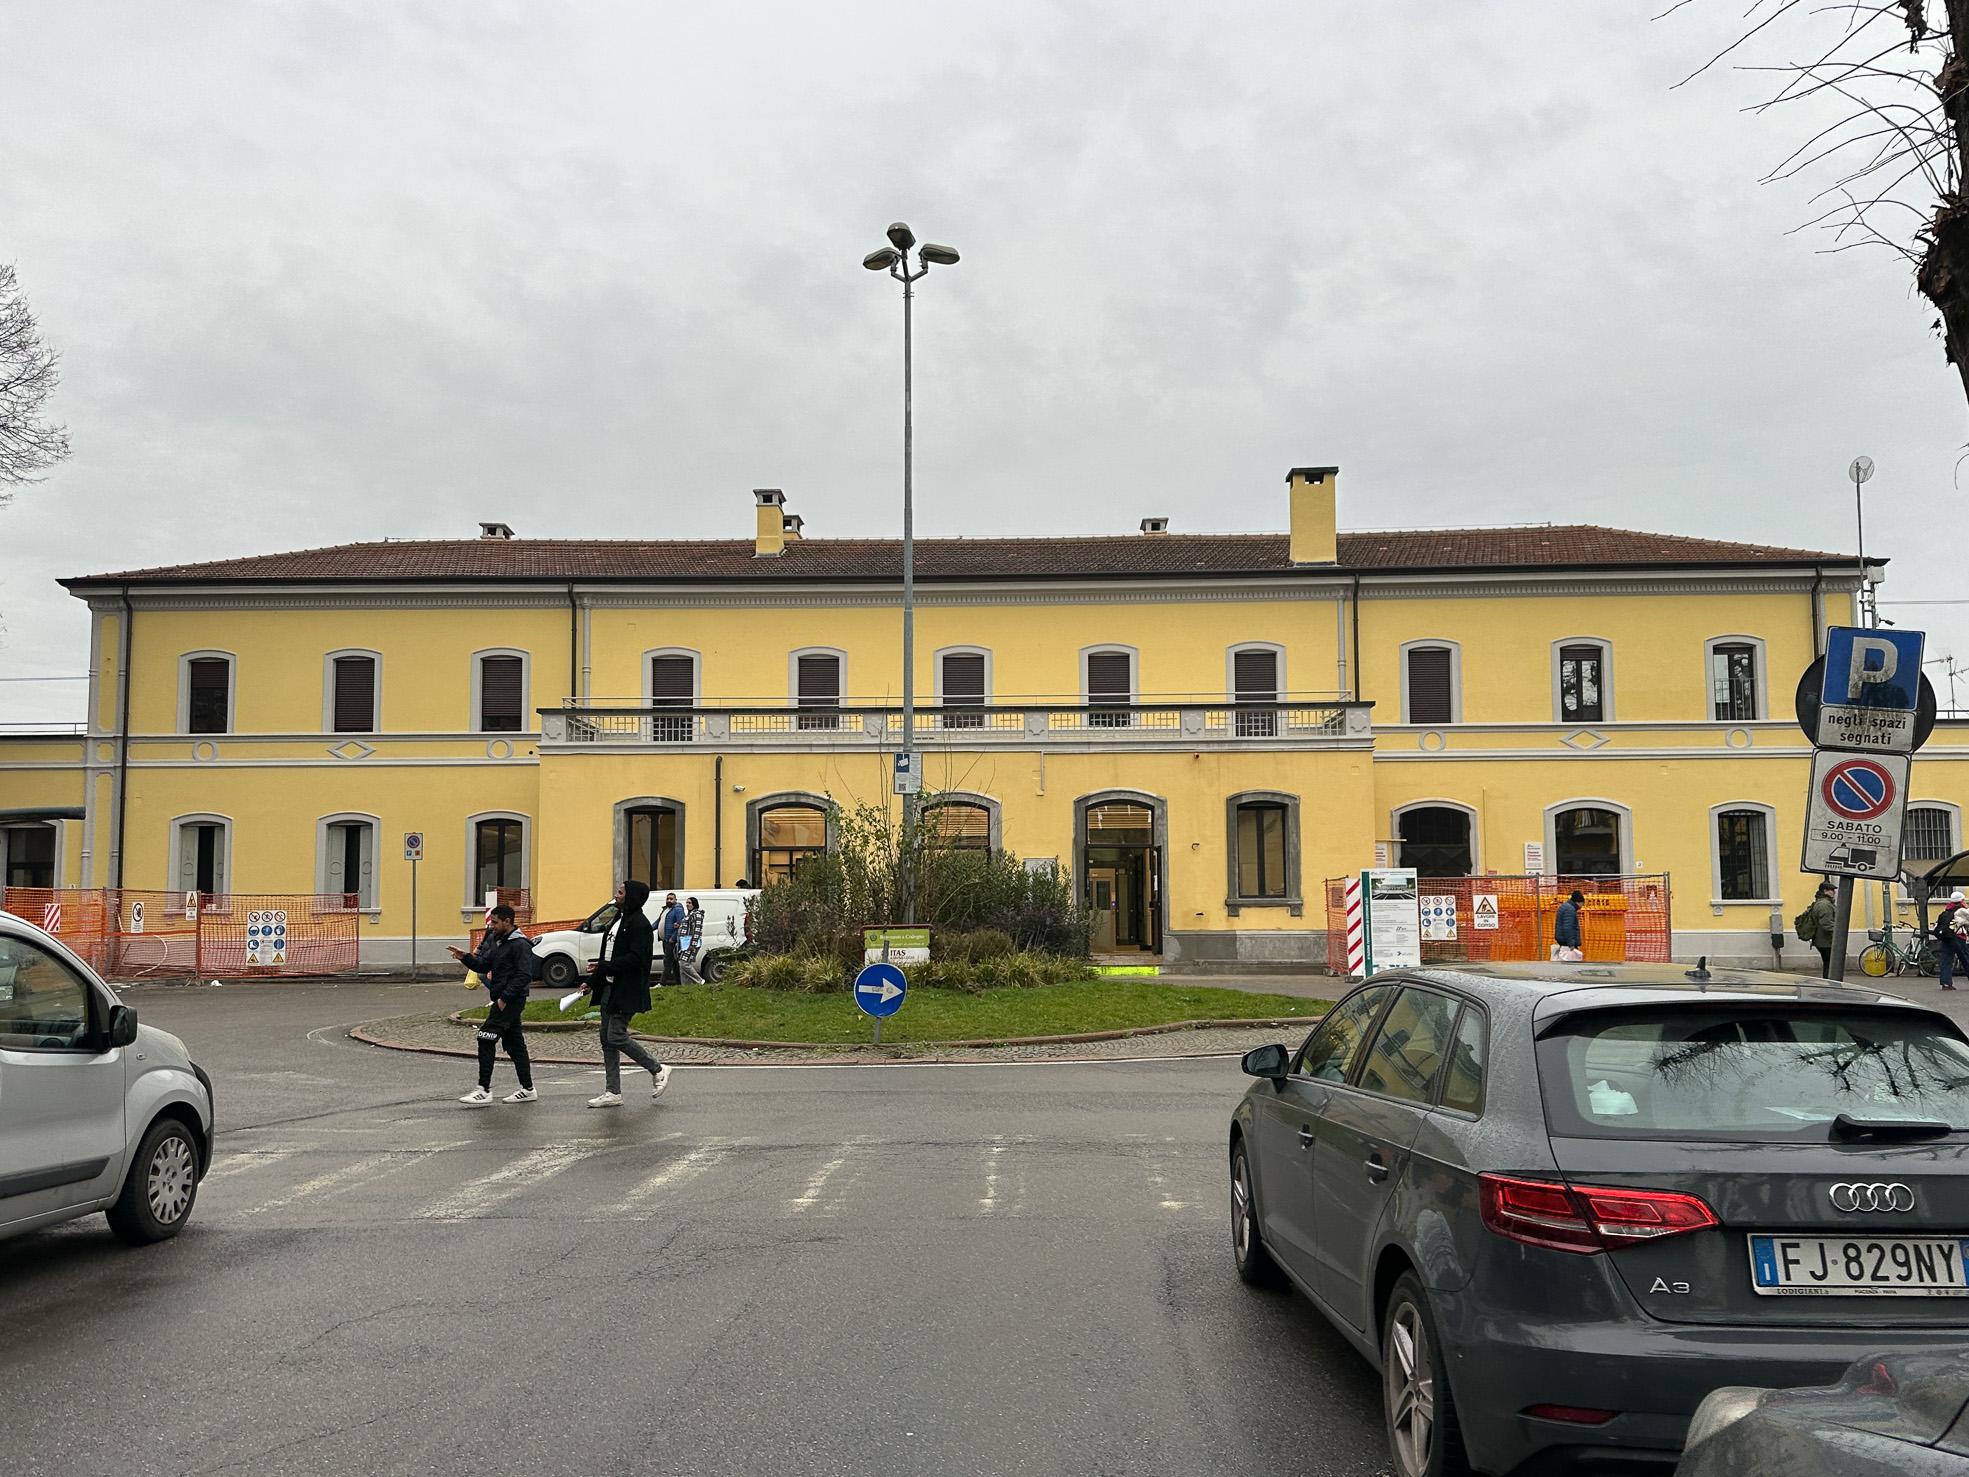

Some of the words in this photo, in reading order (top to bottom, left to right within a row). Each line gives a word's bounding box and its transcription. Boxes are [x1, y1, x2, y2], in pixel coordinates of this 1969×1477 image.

[1848, 636, 1898, 699] P
[1828, 713, 1863, 728] negli
[1871, 716, 1907, 731] spazi
[1840, 731, 1892, 745] segnati
[1827, 820, 1882, 834] SABATO
[1821, 831, 1844, 841] 9.00
[1856, 835, 1881, 845] 11.00
[1649, 1276, 1690, 1294] A3
